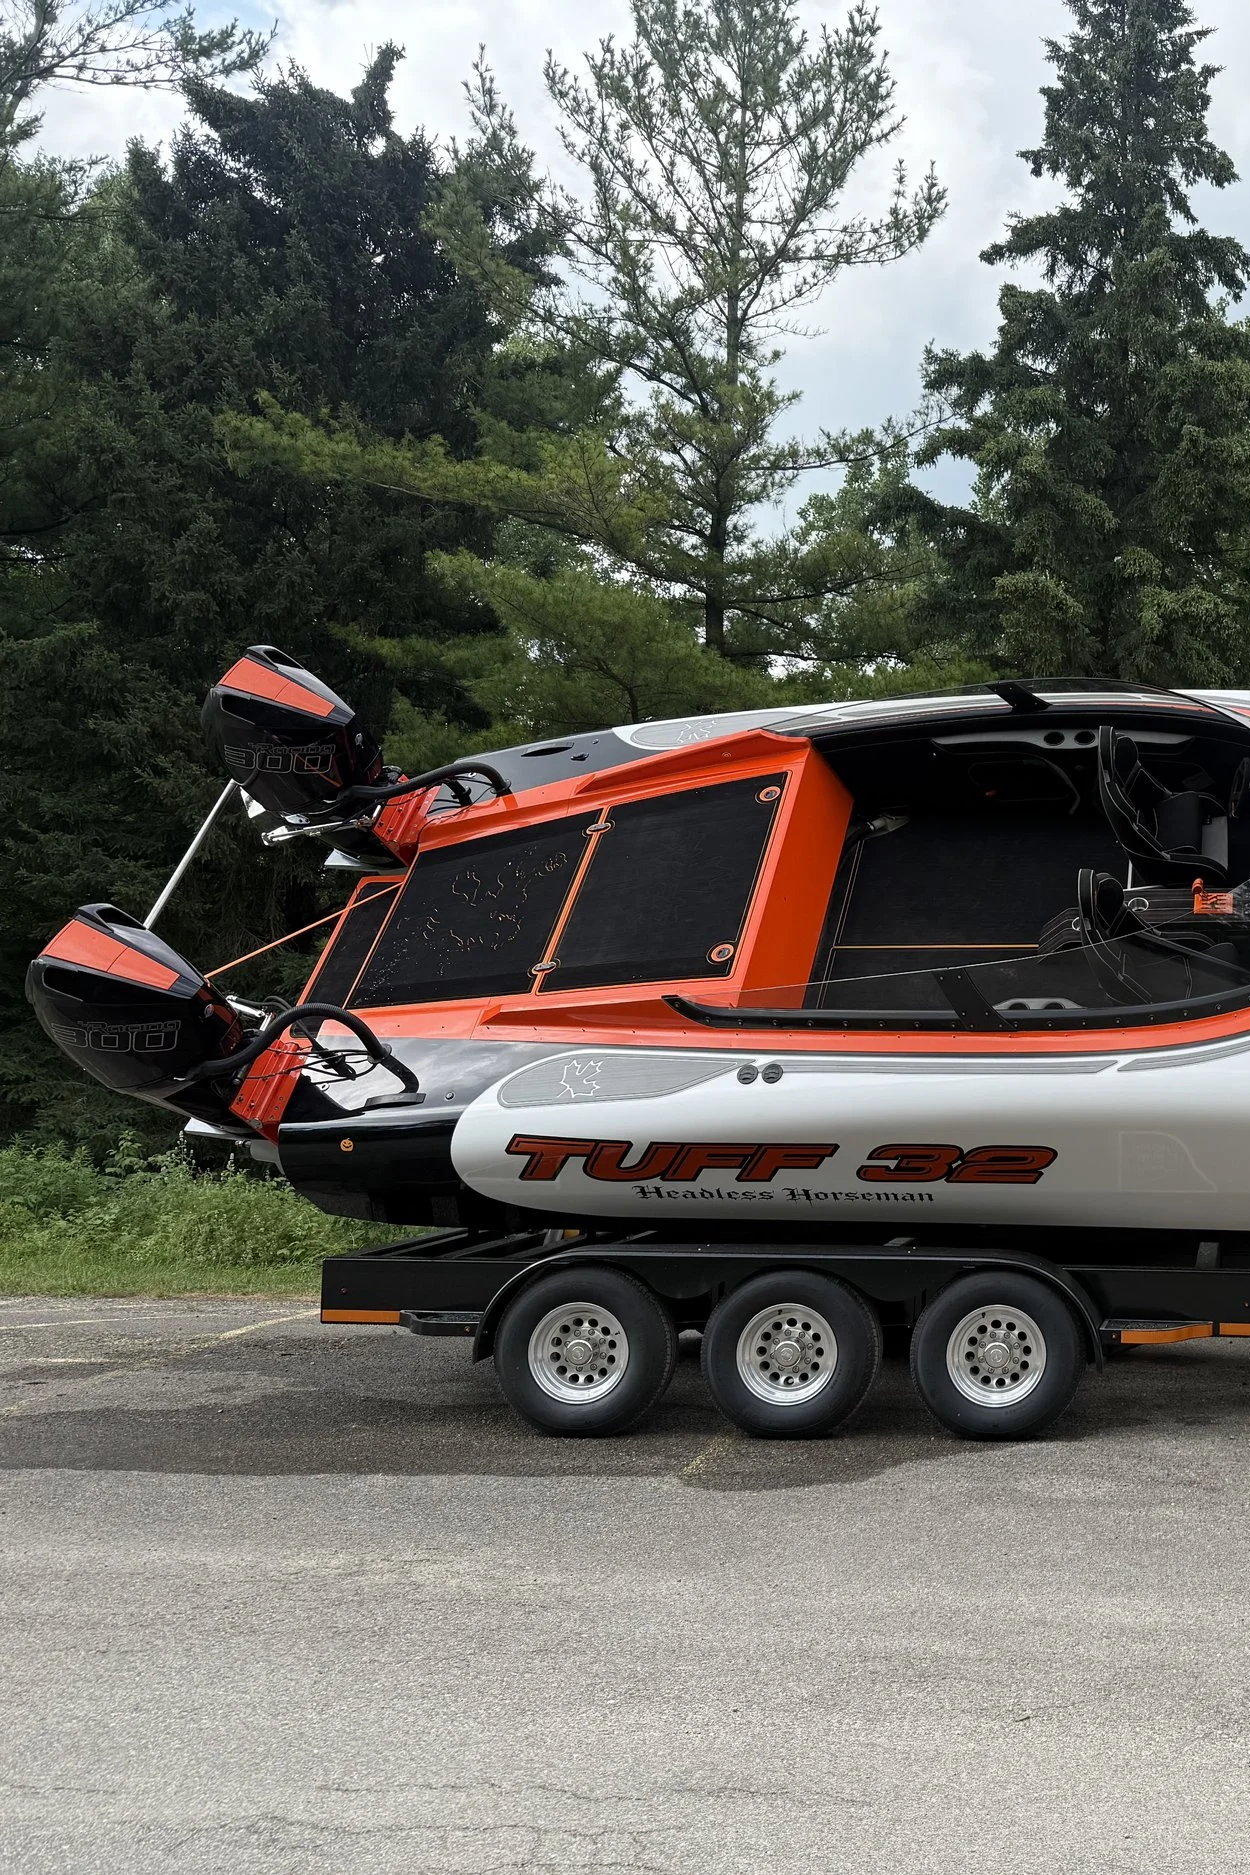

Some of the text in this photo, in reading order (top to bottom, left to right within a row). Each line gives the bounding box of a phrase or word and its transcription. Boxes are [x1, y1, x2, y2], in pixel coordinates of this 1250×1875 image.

[223, 744, 334, 774] 300
[50, 1022, 179, 1053] 300
[506, 1133, 1059, 1185] TUFF 32
[631, 1185, 936, 1208] Headless Horseman
